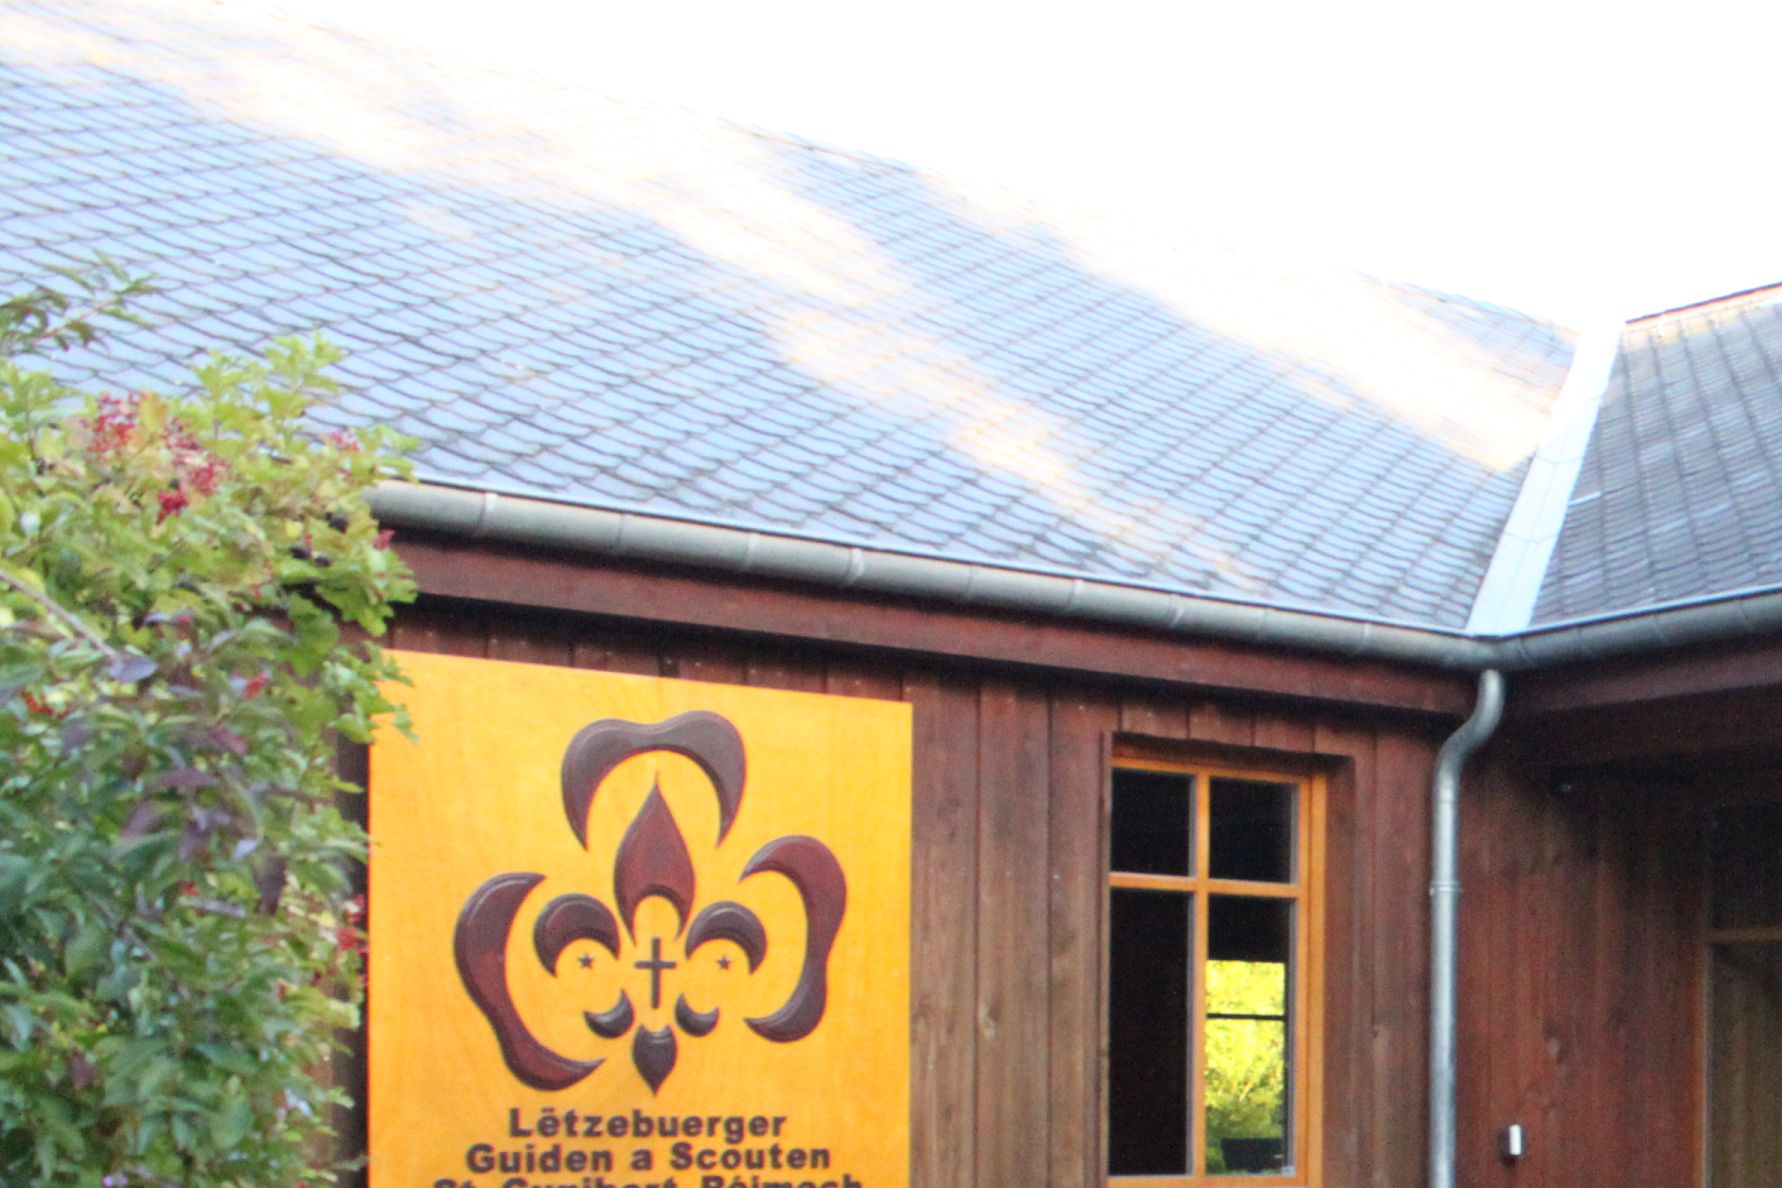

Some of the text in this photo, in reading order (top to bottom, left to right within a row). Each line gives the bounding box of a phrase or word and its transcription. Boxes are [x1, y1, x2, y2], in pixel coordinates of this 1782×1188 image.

[508, 1106, 787, 1144] Lëtzebuerger
[465, 1141, 830, 1174] Guiden a Scouten
